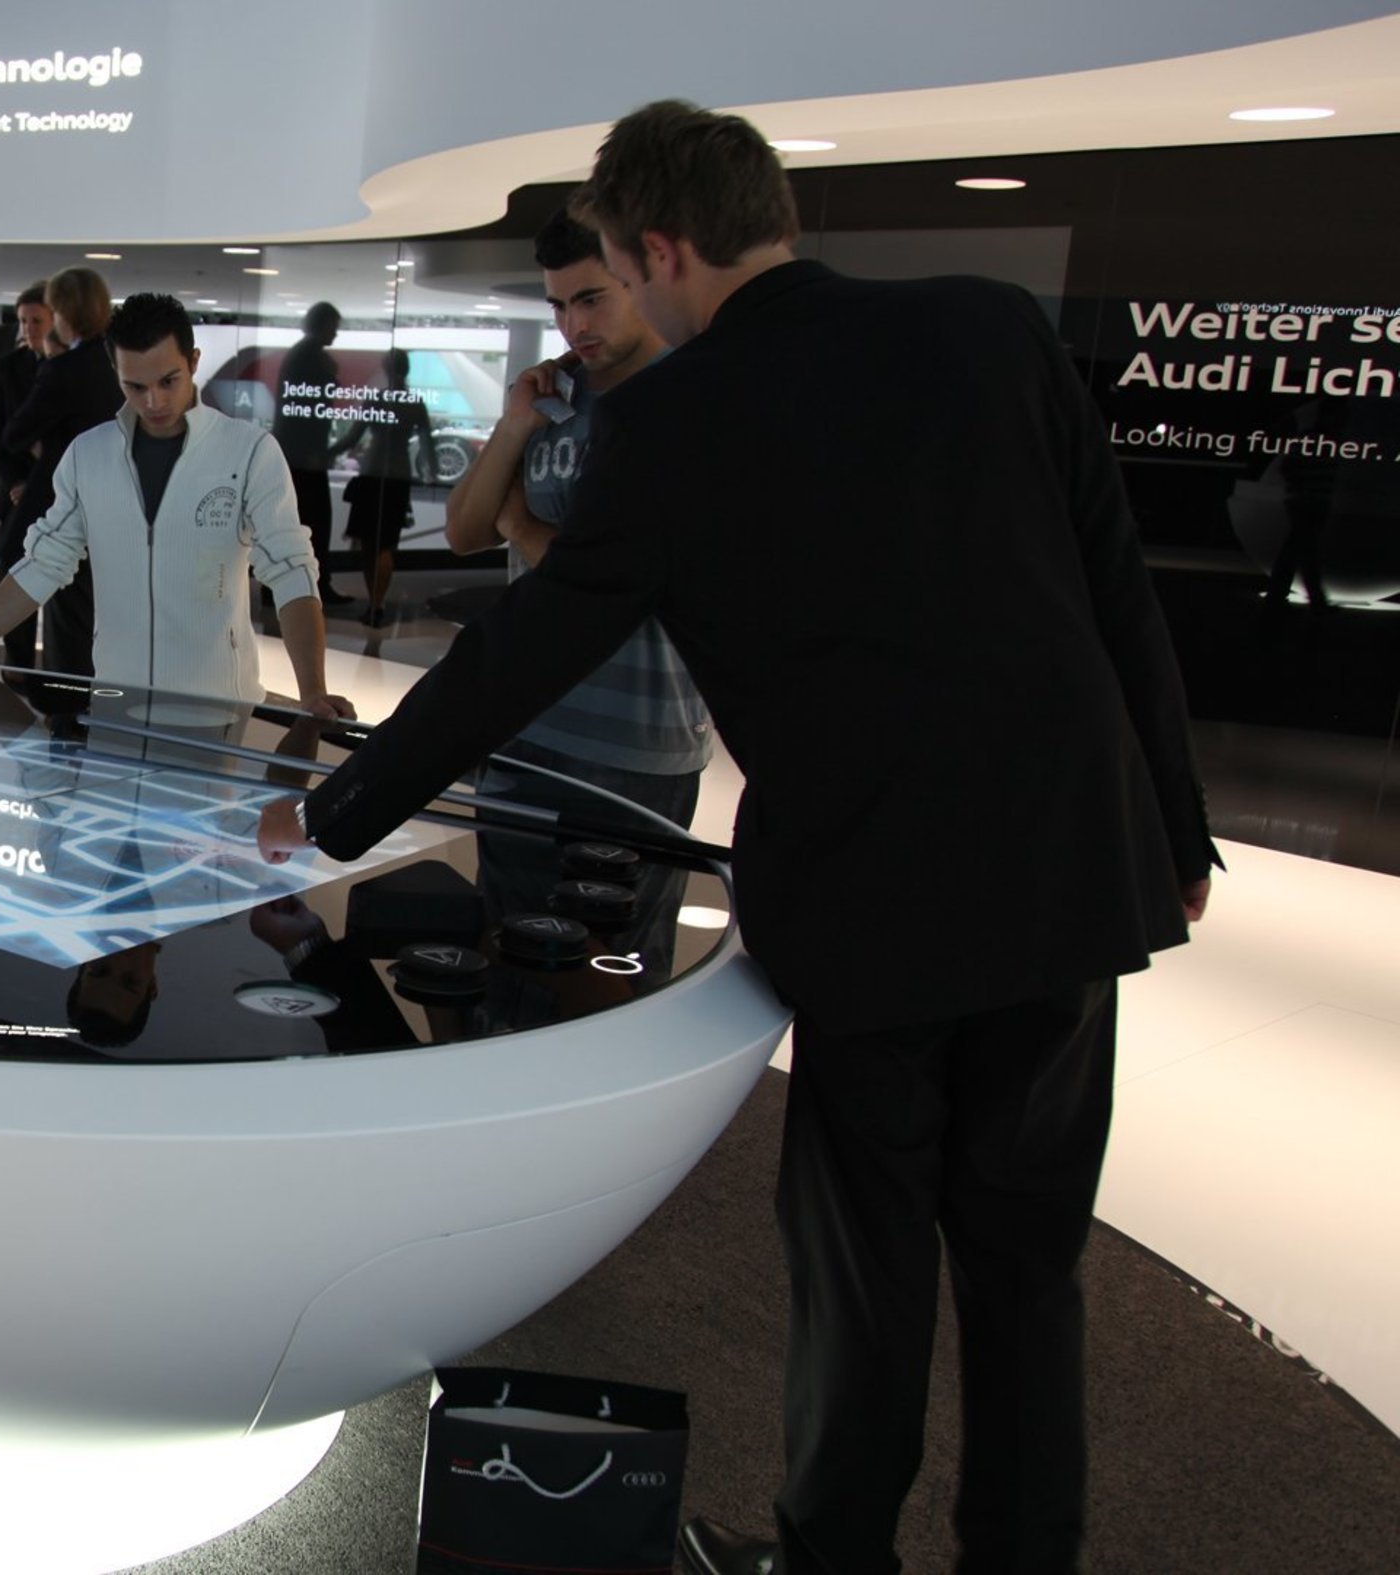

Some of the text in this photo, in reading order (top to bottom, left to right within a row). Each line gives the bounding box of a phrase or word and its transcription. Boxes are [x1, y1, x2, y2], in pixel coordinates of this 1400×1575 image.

[14, 109, 134, 133] Technology
[1128, 301, 1333, 342] Weiter
[1116, 351, 1400, 398] Audi Lich
[282, 381, 322, 399] Jedes
[324, 383, 380, 401] Gesicht
[281, 403, 400, 425] eine Geschichte.
[1109, 421, 1383, 461] Looking further.
